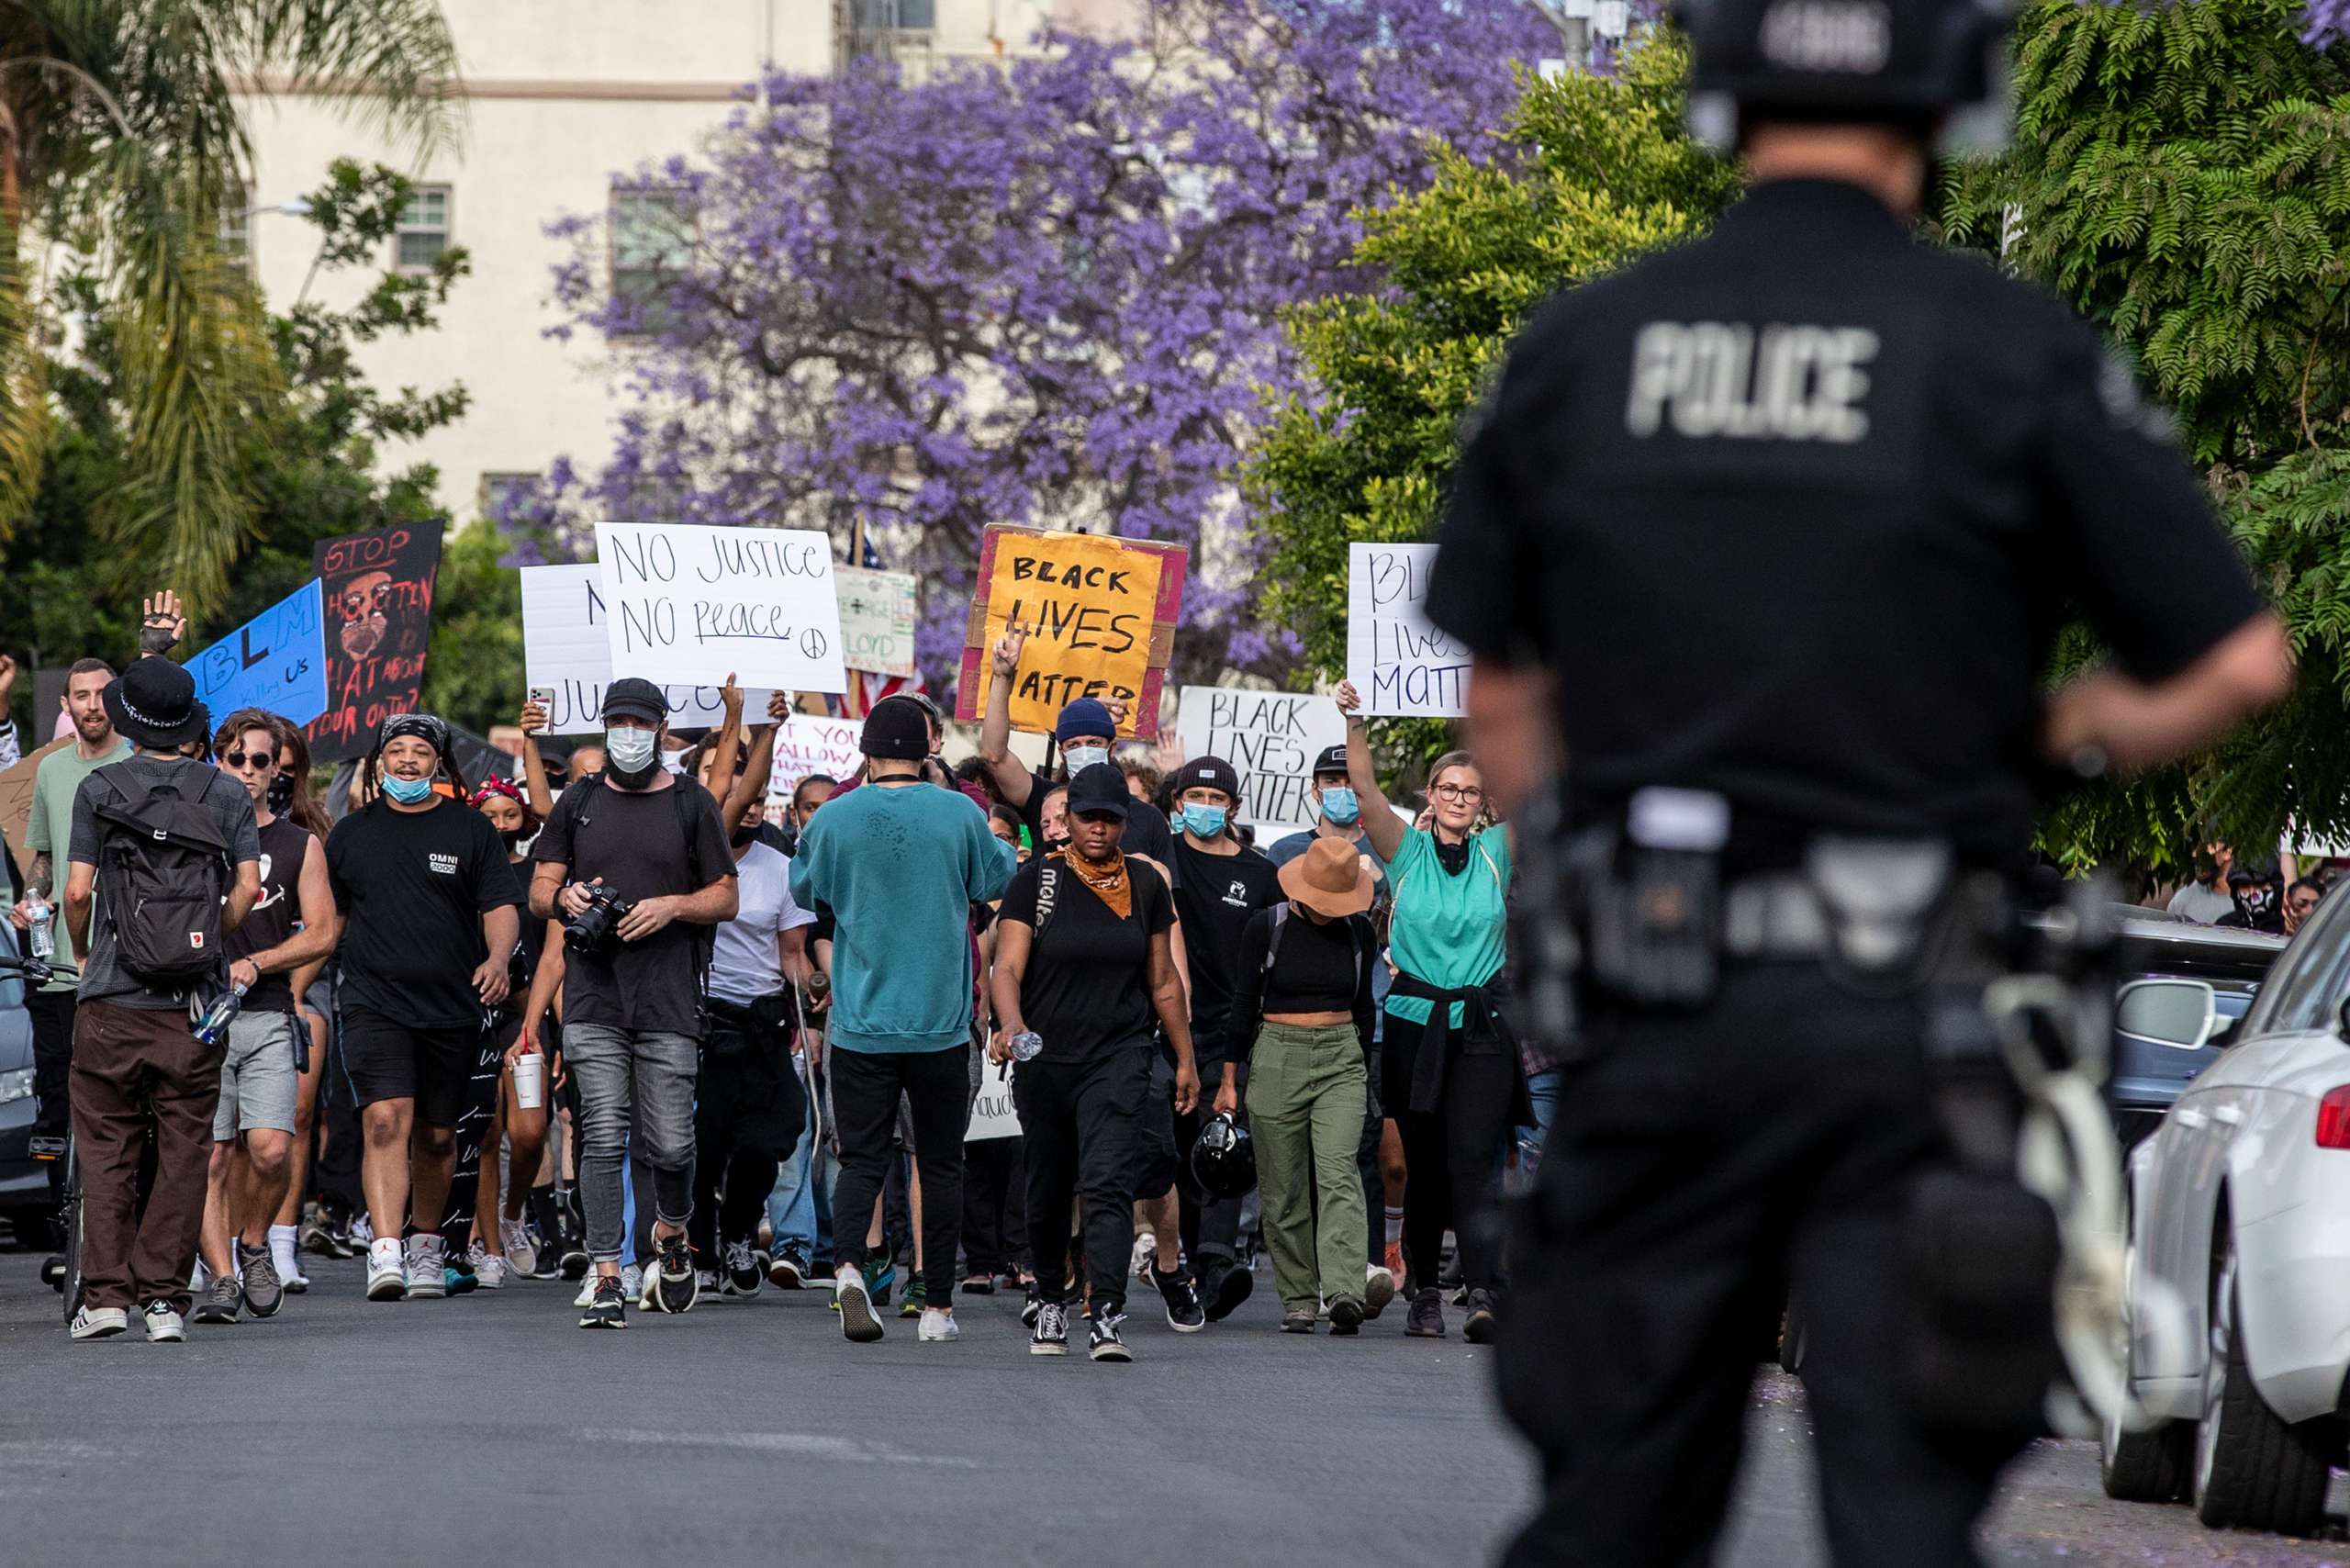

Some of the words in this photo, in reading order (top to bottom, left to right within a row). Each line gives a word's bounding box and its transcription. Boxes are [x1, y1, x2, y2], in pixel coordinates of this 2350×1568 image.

[1626, 322, 1881, 443] POLICE
[324, 530, 411, 572] STOP
[611, 532, 676, 584] NO
[1013, 557, 1131, 594] BLACK
[202, 586, 317, 696] BLM
[621, 597, 676, 653] NO
[841, 631, 895, 659] LOYD
[1006, 599, 1140, 654] LIVES
[327, 655, 383, 699] HAT
[990, 669, 1136, 715] ATTER
[1211, 693, 1310, 737] BLACK
[1238, 771, 1318, 825] ATTER
[429, 853, 458, 865] OMNI
